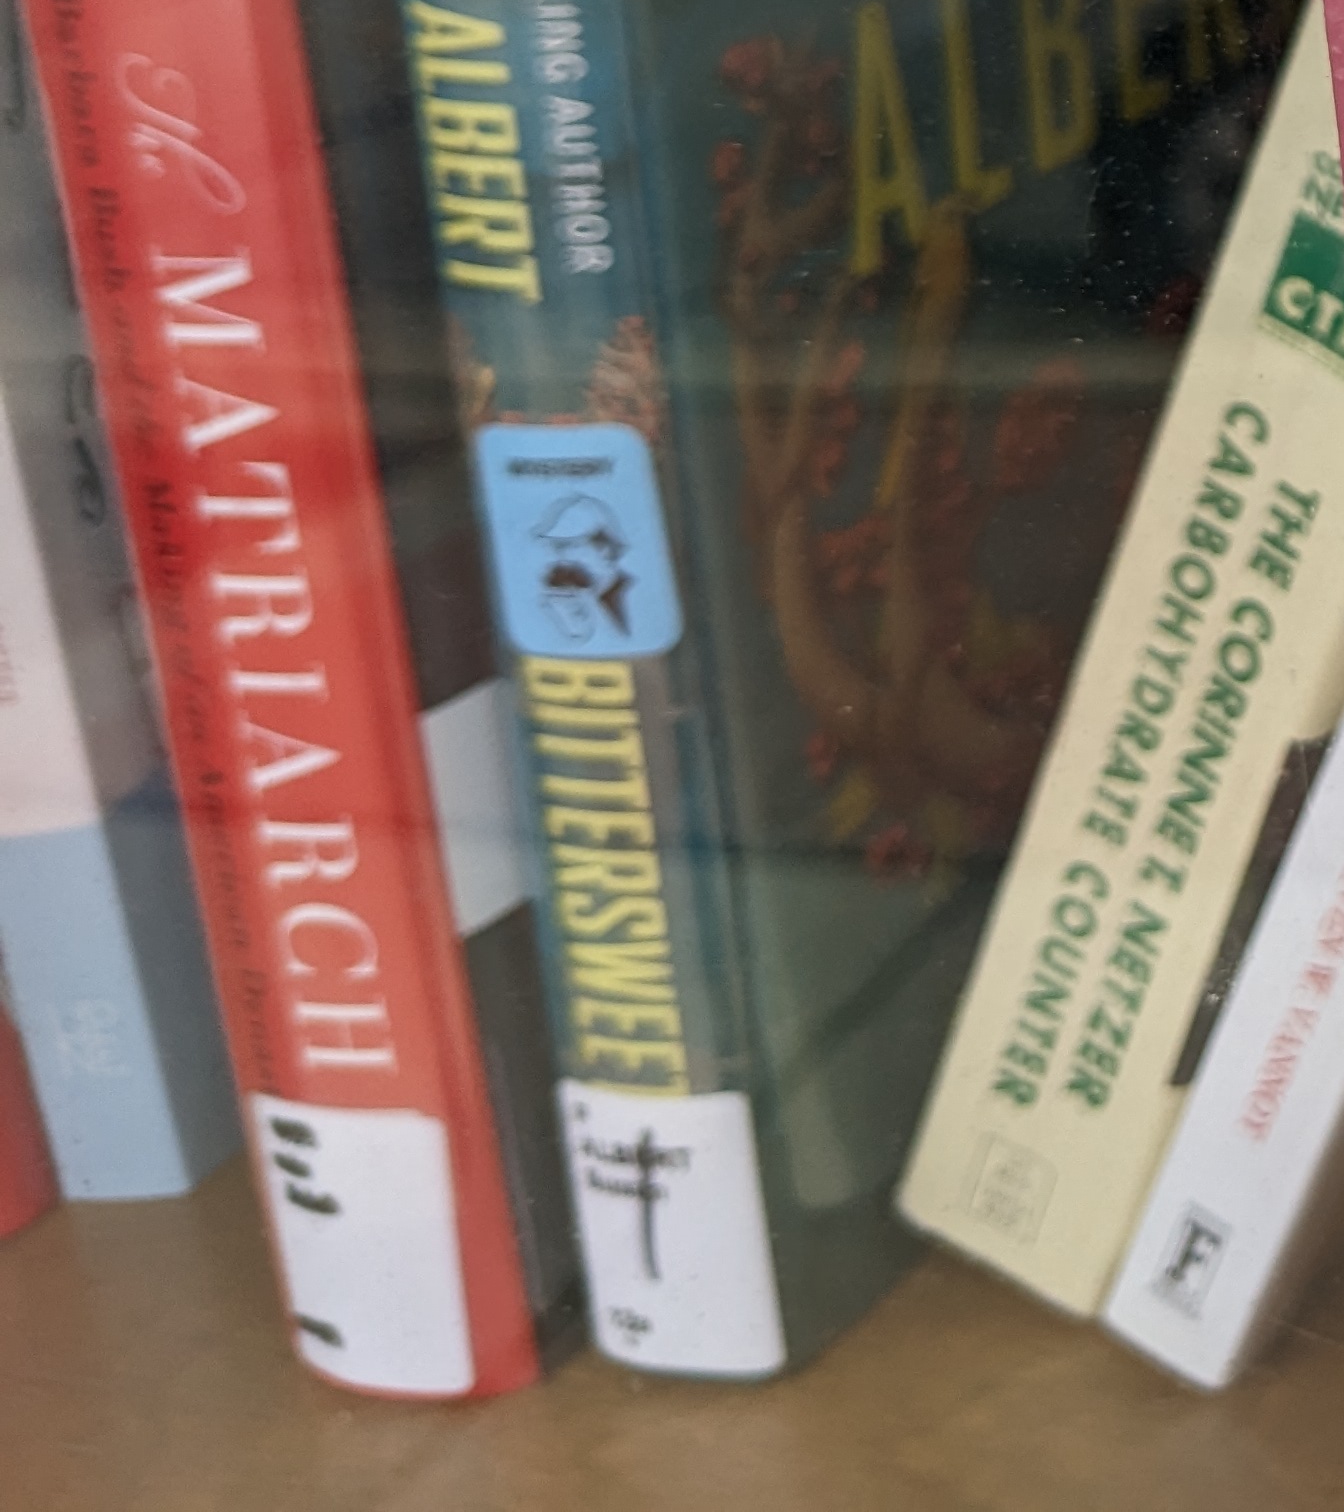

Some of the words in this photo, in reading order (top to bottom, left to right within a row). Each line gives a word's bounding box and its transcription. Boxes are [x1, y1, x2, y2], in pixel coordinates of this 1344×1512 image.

[408, 0, 542, 305] ALBERT
[545, 94, 615, 276] AUTHOR
[150, 244, 400, 1076] MATRIARCH
[1080, 399, 1270, 848] CARBOHYDRATE
[1246, 479, 1322, 591] THE
[1147, 595, 1284, 850] CORINNE
[989, 857, 1112, 1110] COUNTER
[1060, 900, 1168, 1115] NETZER
